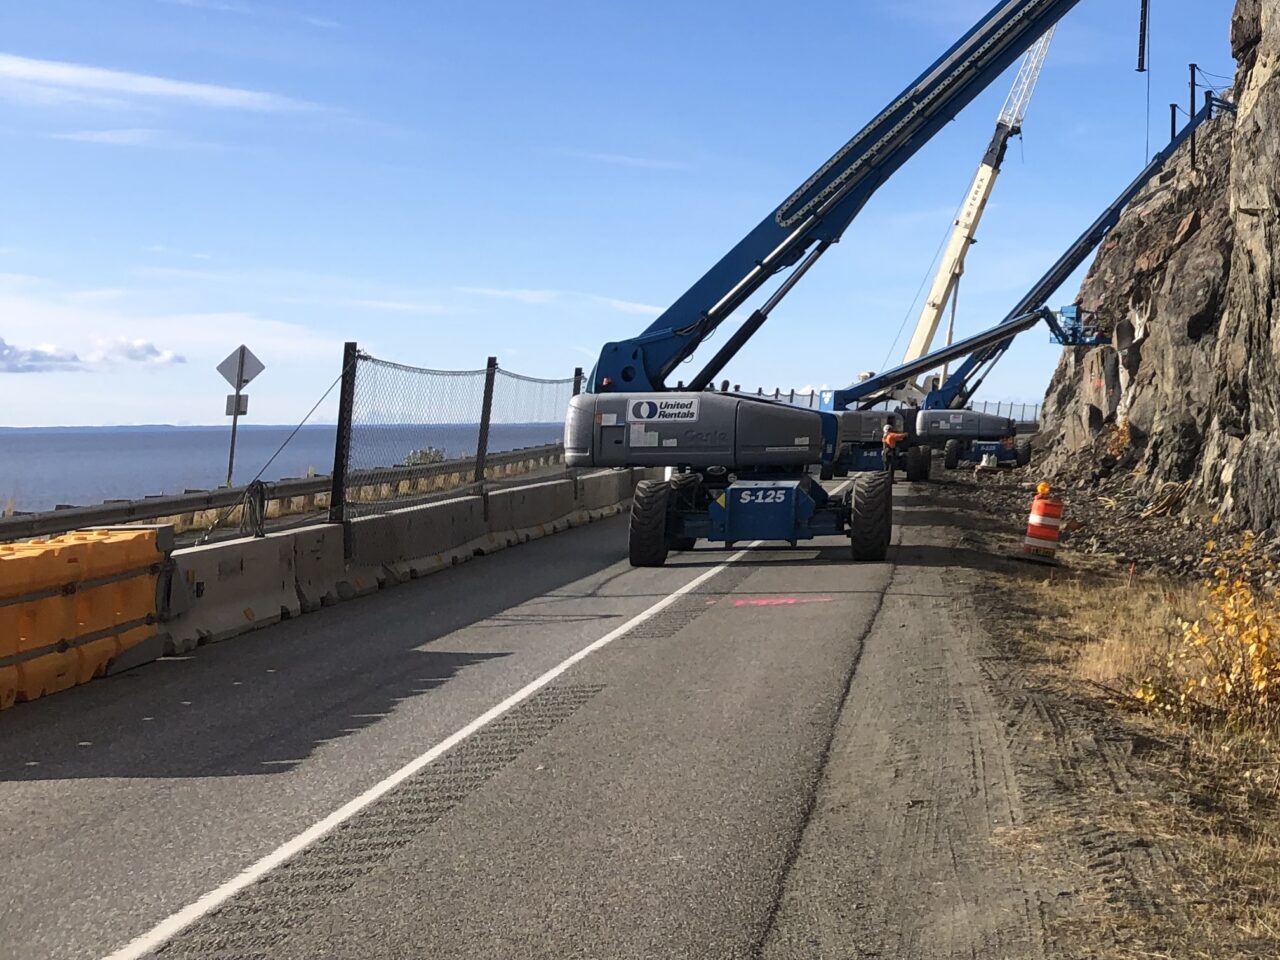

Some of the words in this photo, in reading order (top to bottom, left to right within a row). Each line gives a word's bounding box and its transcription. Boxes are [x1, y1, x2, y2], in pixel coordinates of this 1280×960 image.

[659, 401, 694, 410] United
[657, 410, 695, 419] Rentals
[740, 490, 786, 504] S-125
